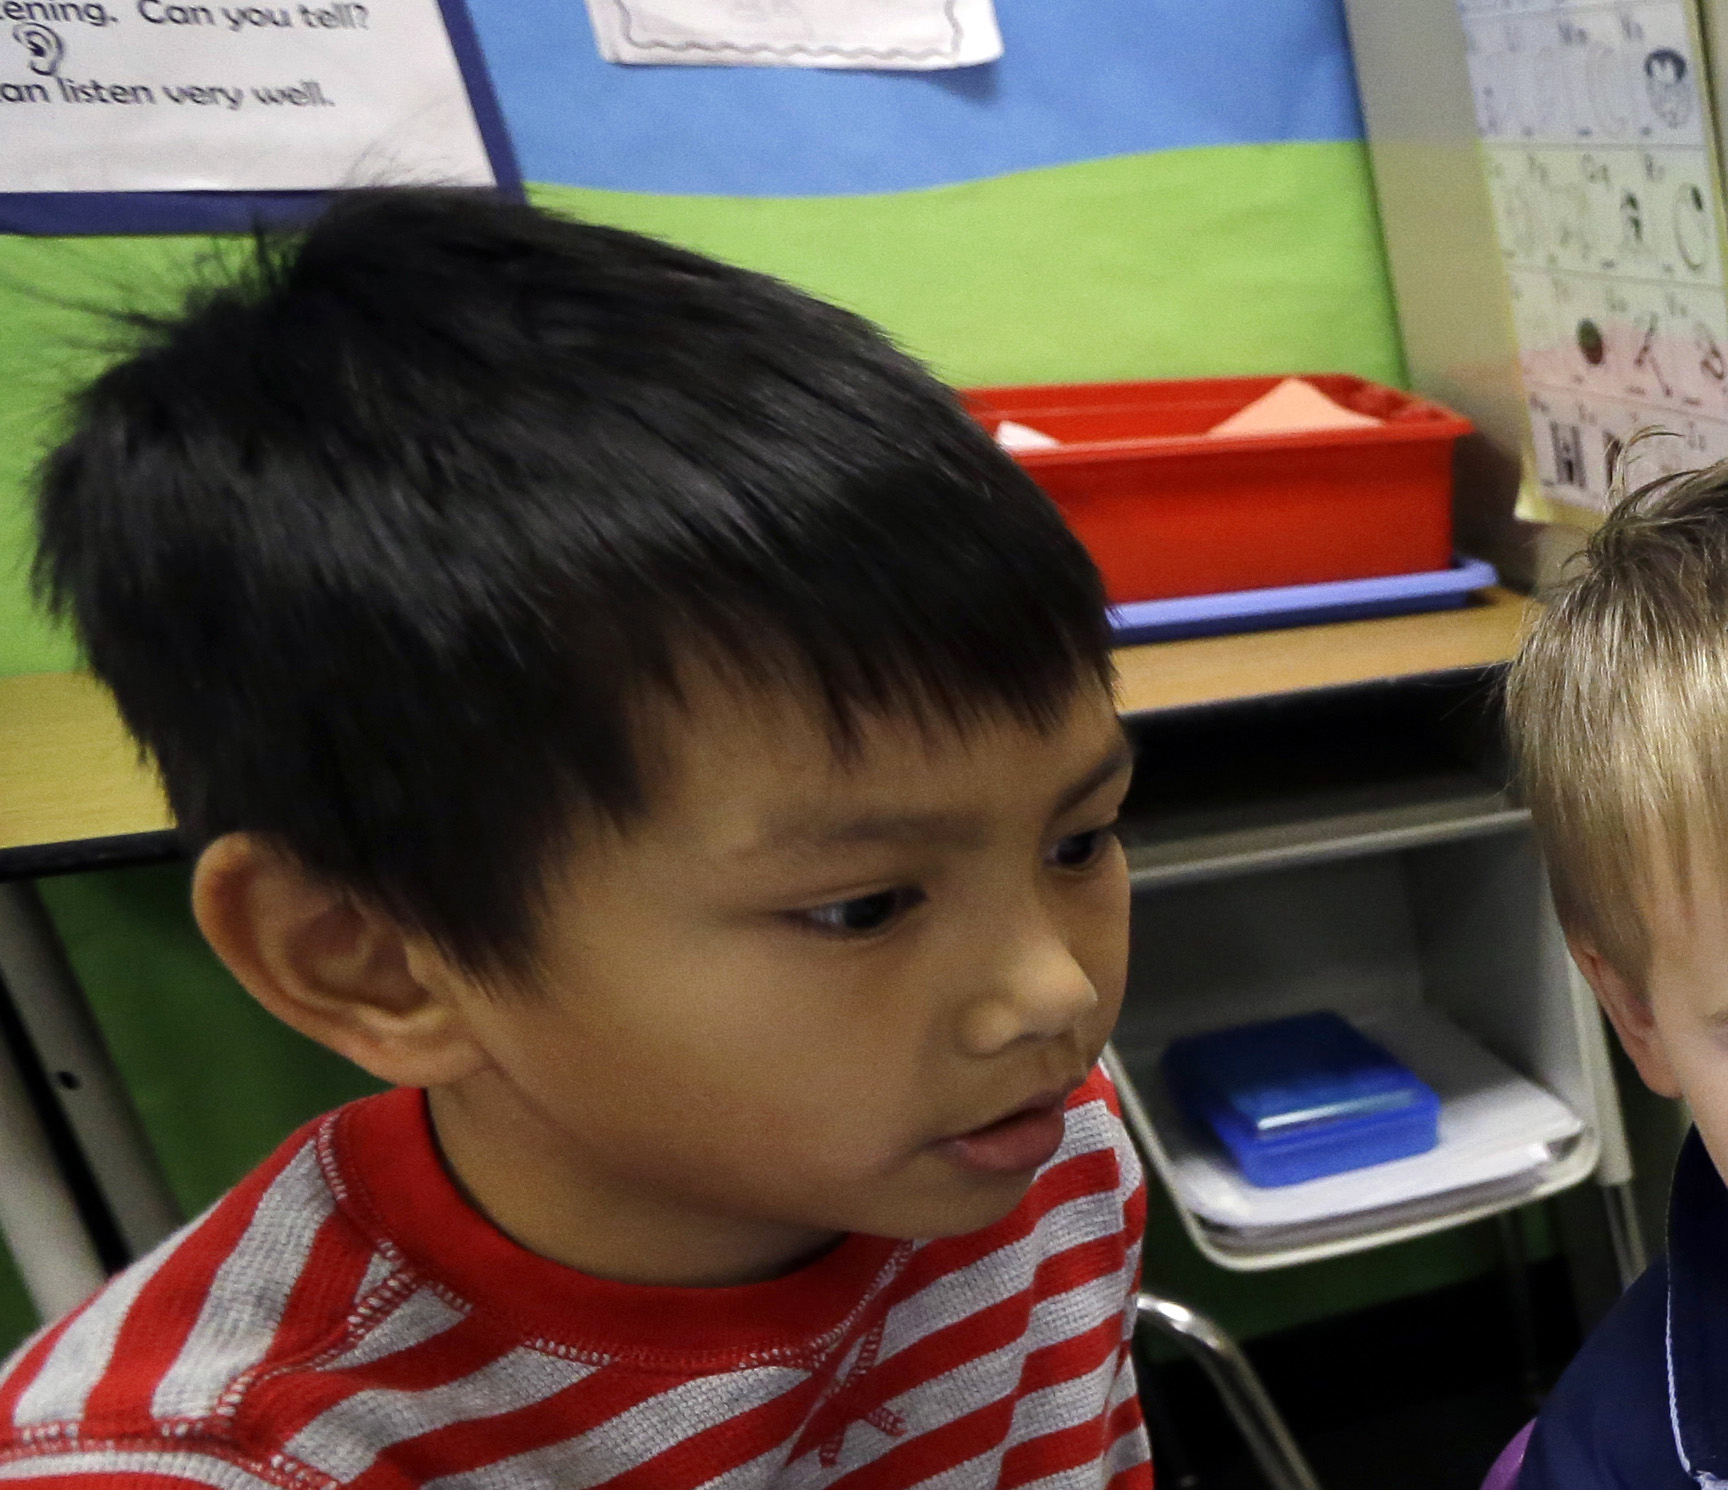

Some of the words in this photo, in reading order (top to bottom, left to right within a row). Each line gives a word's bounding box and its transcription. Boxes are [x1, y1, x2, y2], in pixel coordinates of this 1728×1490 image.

[137, 0, 214, 25] Can
[220, 7, 293, 32] you
[298, 3, 369, 30] tell?
[56, 76, 156, 104] listen
[162, 86, 244, 111] very
[251, 81, 335, 107] well.
